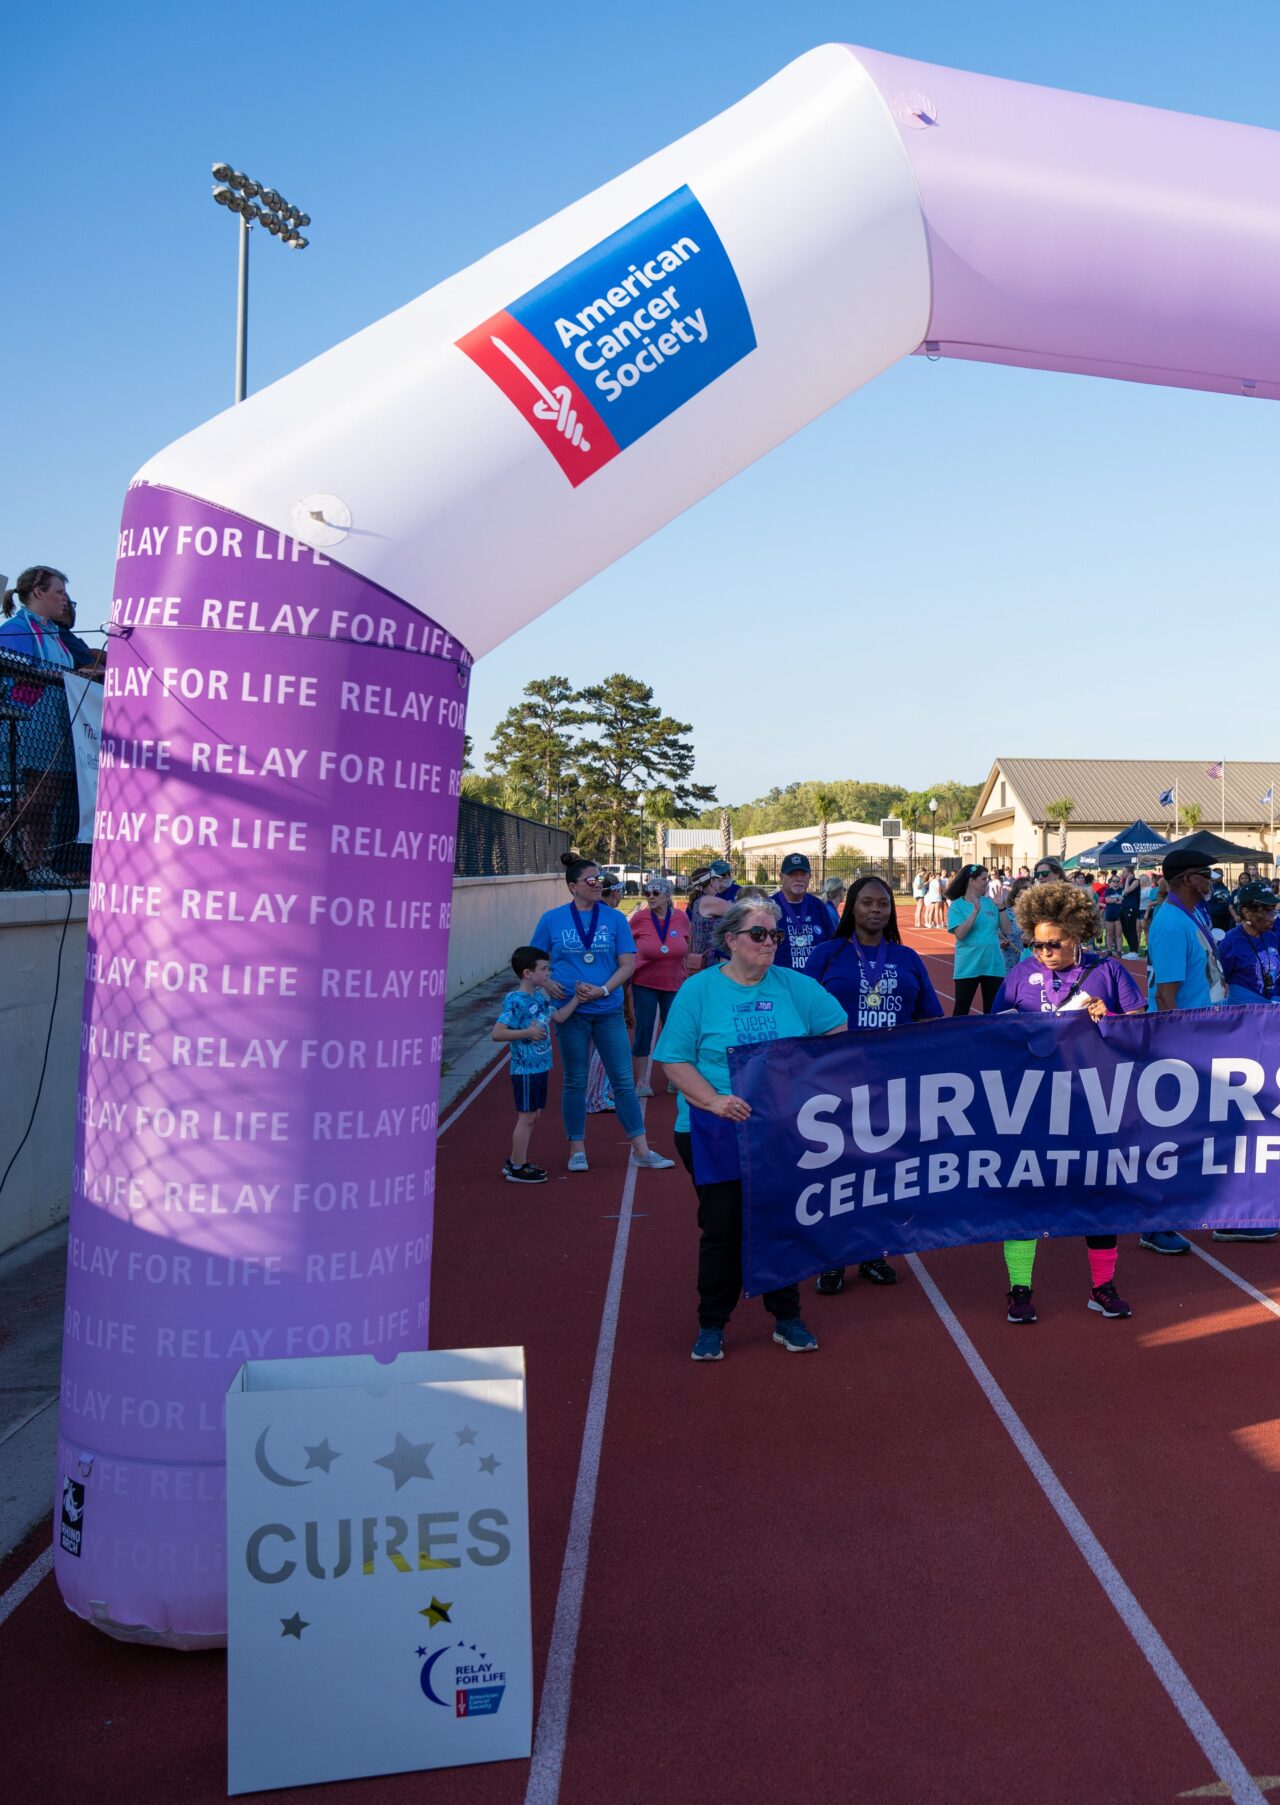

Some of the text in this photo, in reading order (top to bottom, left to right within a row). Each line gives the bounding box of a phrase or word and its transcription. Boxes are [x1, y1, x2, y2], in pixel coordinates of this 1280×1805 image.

[554, 236, 701, 348] American
[574, 285, 681, 371] Cancer
[595, 307, 709, 402] Society
[177, 526, 243, 558] FOR
[121, 597, 181, 626] LIFE
[201, 599, 319, 636] RELAY
[330, 611, 396, 646] FOR
[406, 623, 454, 659] LIFE
[164, 668, 227, 700] FOR
[242, 672, 317, 706] LIFE
[341, 681, 433, 722] RELAY
[438, 700, 466, 730] FOR
[121, 741, 170, 770] LIFE
[192, 742, 307, 779] RELAY
[319, 752, 384, 786] FOR
[394, 761, 440, 794] LIFE
[94, 811, 454, 862] RELAY FOR LIFE RELAY FOR
[111, 884, 162, 916] LIFE
[181, 888, 298, 924] RELAY
[309, 895, 374, 928] FOR
[384, 901, 431, 929] LIFE
[85, 952, 445, 998] RELAY FOR LIFE RELAY FOR
[102, 1029, 152, 1063] LIFE
[173, 1036, 288, 1068] RELAY
[301, 1039, 365, 1069] FOR
[376, 1038, 423, 1068] LIFE
[76, 1093, 437, 1141] RELAY FOR LIFE RELAY FOR
[93, 1173, 144, 1209] LIFE
[164, 1182, 281, 1214] RELAY
[293, 1181, 359, 1212] FOR
[369, 1173, 416, 1208] LIFE
[794, 1141, 1179, 1226] CELEBRATING
[68, 1232, 431, 1286] RELAY FOR LIFE RELAY FOR
[85, 1317, 136, 1354] LIFE
[156, 1328, 273, 1358] RELAY
[286, 1323, 352, 1353] FOR
[362, 1309, 409, 1346] LIFE
[120, 1397, 185, 1431] FOR
[149, 1469, 226, 1501] REL
[245, 1509, 511, 1584] CURES
[456, 1663, 492, 1675] RELAY
[456, 1672, 506, 1685] FOR LIFE
